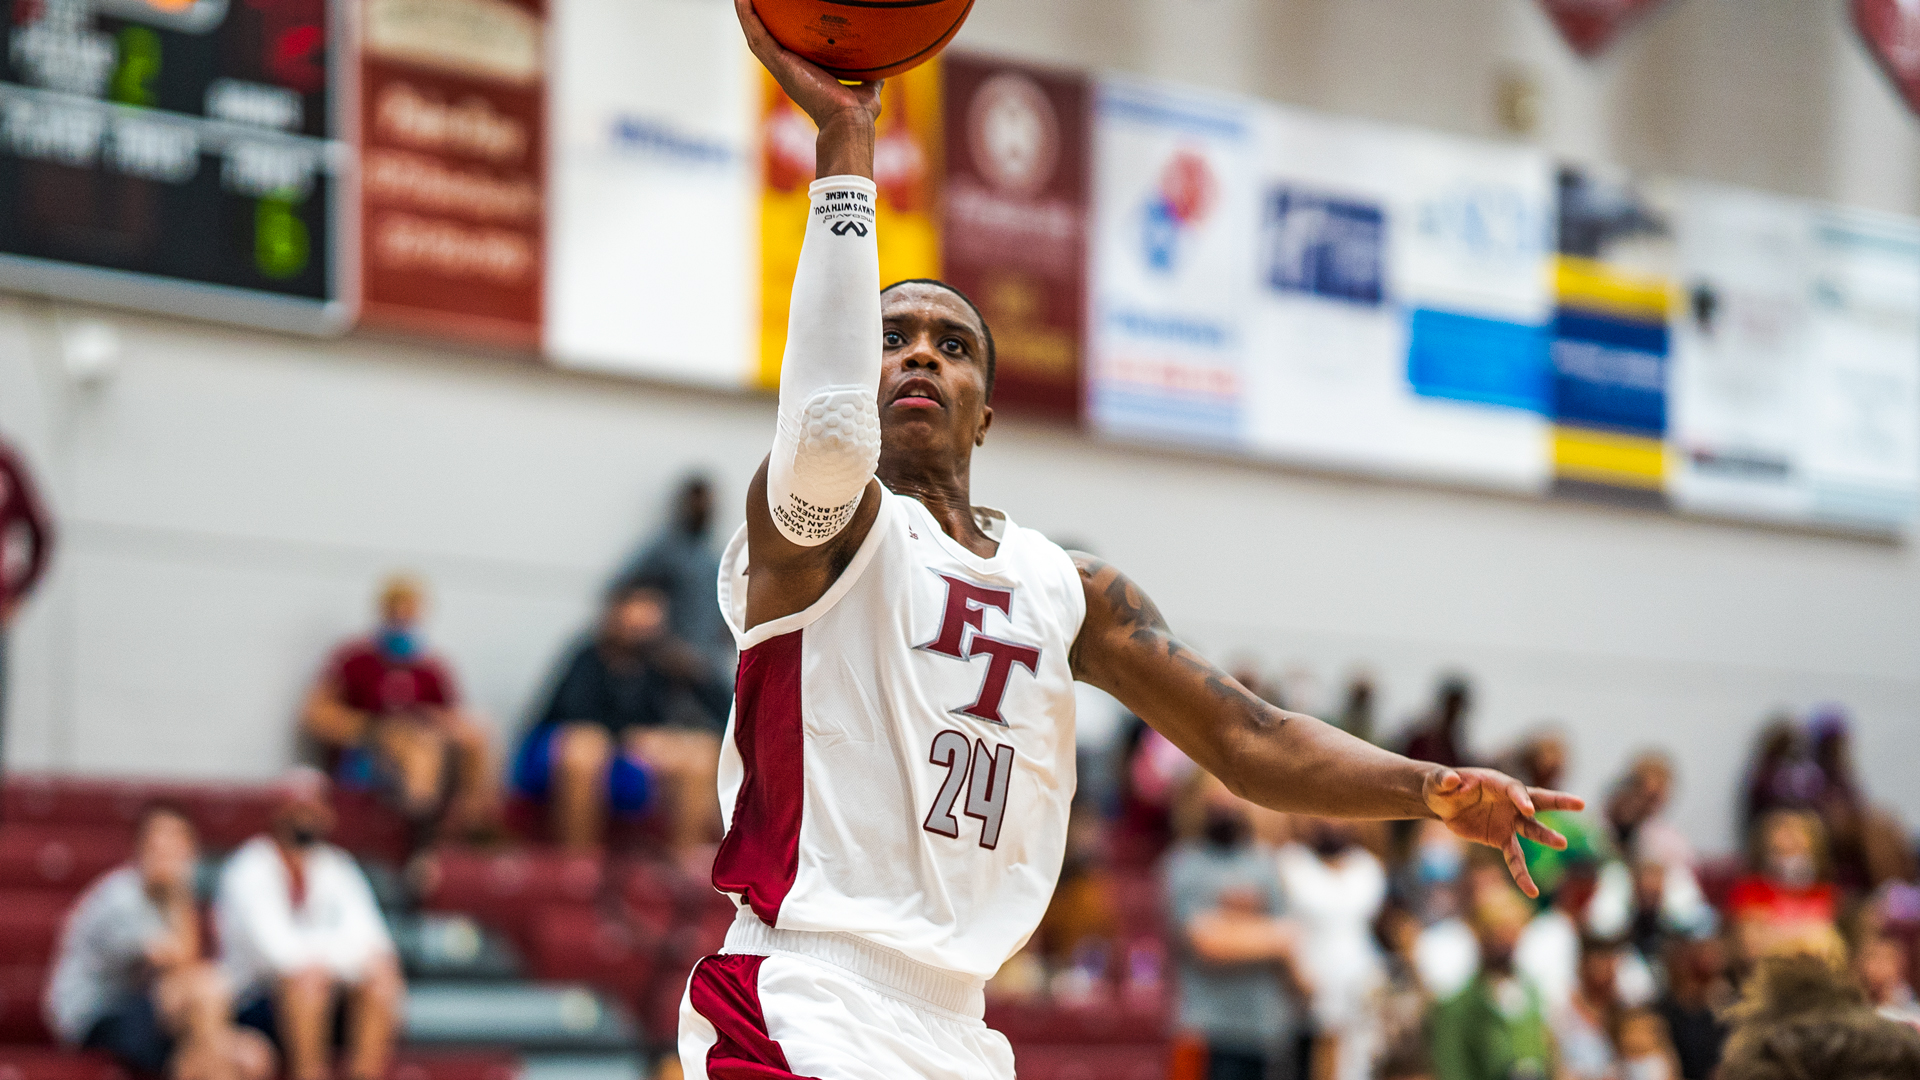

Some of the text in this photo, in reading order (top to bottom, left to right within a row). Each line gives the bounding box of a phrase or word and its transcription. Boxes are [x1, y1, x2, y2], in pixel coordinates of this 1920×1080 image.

[825, 191, 868, 203] DAD & MEME
[813, 203, 875, 217] ALWAYS WITH YOU.
[789, 493, 830, 514] BRYANT
[773, 508, 802, 536] REACH
[777, 505, 804, 531] WHEN
[791, 510, 805, 523] GO
[807, 520, 832, 528] CAN
[807, 526, 836, 534] LIMIT
[911, 566, 1042, 728] FT
[923, 729, 1014, 850] 24
